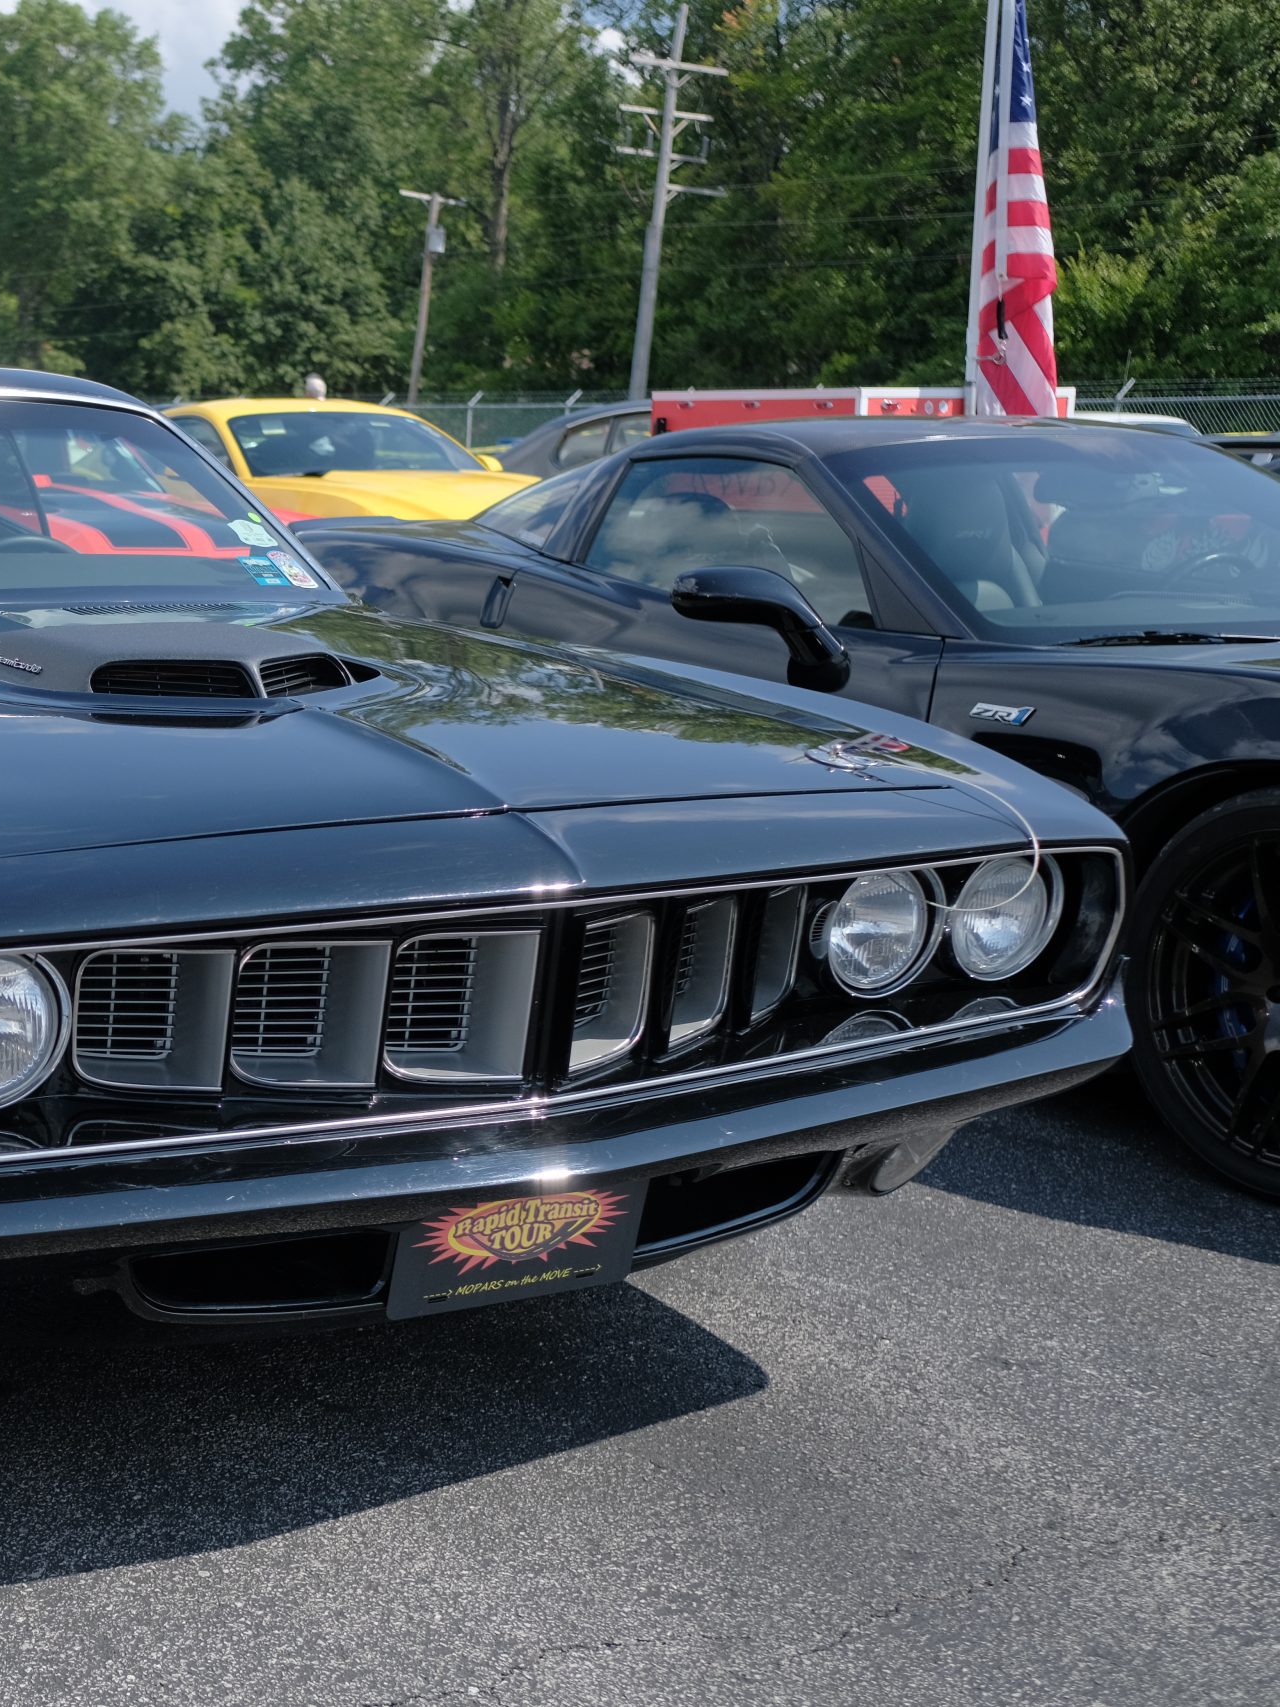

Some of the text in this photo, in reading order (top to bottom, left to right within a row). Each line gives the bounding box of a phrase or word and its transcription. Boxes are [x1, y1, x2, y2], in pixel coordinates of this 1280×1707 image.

[970, 704, 1036, 726] ZR1
[454, 1198, 600, 1237] Rapid Transit
[490, 1223, 552, 1250] TOUR
[455, 1268, 572, 1296] MOPARS on the MOVE
